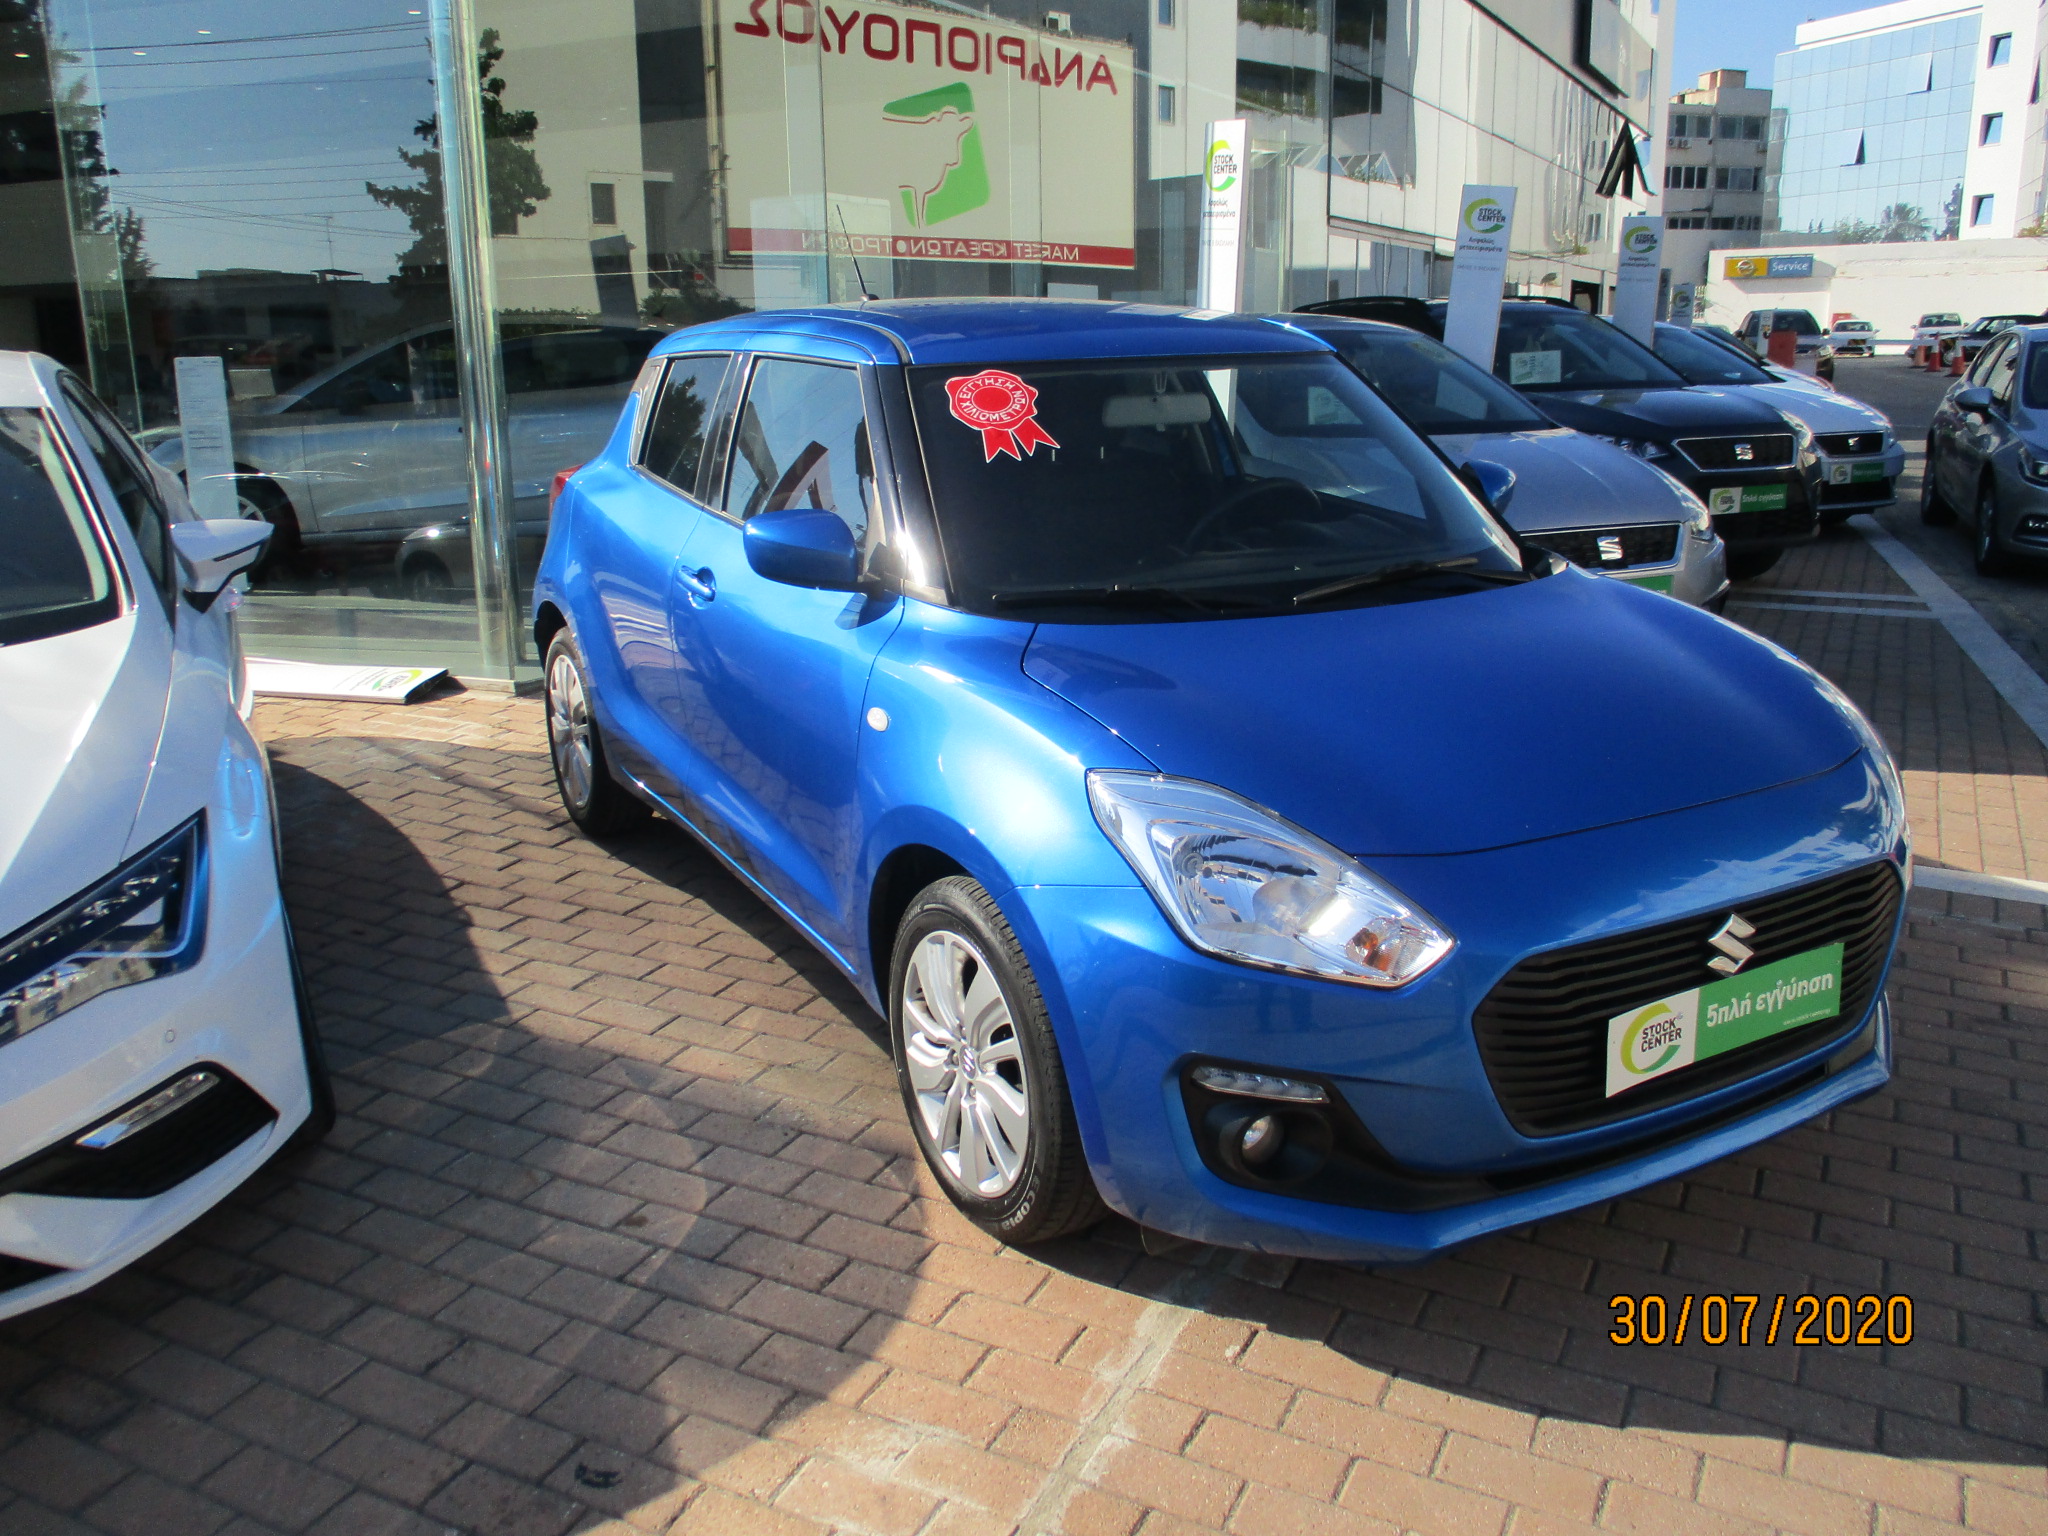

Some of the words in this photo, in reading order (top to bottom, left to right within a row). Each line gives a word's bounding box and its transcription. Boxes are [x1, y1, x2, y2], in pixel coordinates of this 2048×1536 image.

[1214, 154, 1234, 164] STOCK
[1214, 164, 1238, 174] CENTER
[1478, 214, 1506, 223] CENTER
[1479, 208, 1503, 216] STOCK
[1772, 261, 1809, 271] Service
[960, 378, 1016, 399] ΕΓΓΥΗΣΗ
[960, 390, 1026, 421] ΧΙΛΙΟΜΕΤΡΩΝ
[1706, 992, 1751, 1028] 5πλή
[1756, 972, 1834, 1010] εγγύηση
[1641, 1017, 1677, 1040] STOCK
[1641, 1027, 1682, 1053] CENTER
